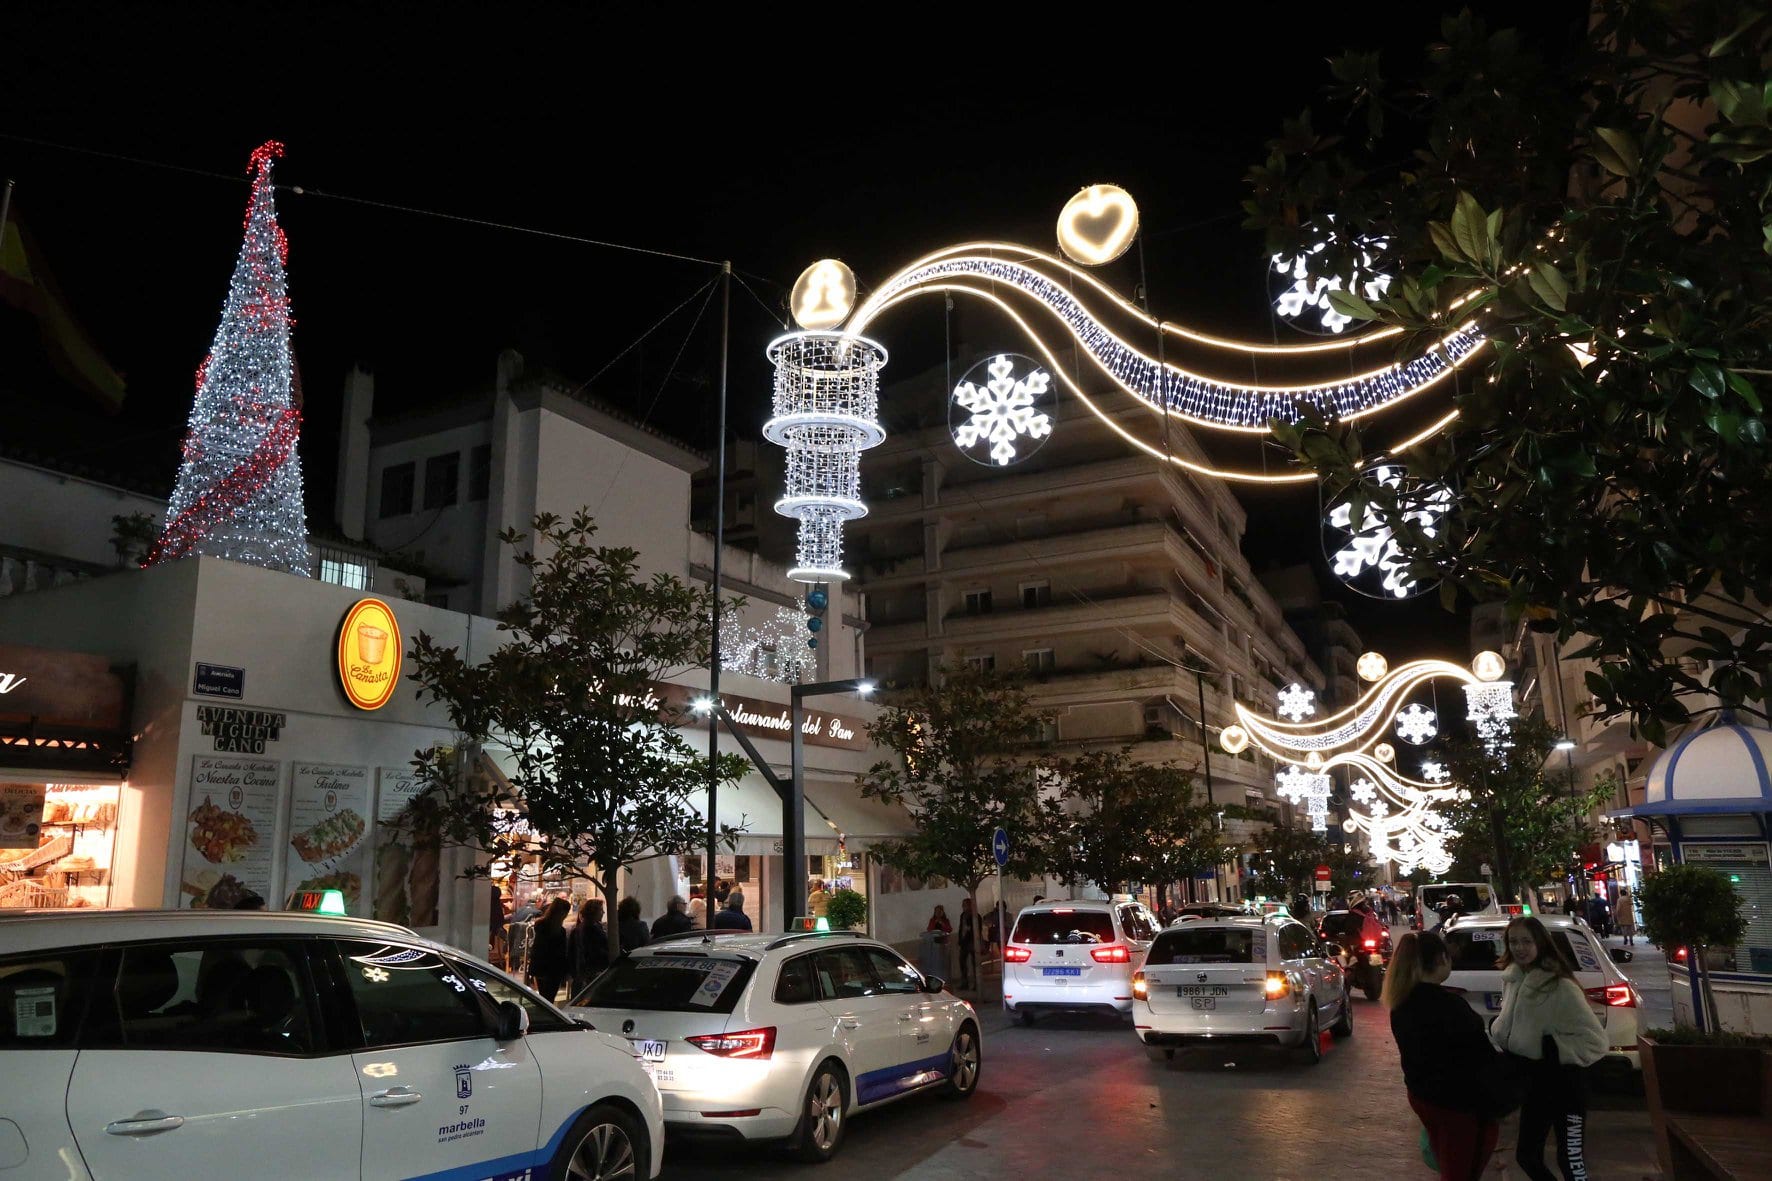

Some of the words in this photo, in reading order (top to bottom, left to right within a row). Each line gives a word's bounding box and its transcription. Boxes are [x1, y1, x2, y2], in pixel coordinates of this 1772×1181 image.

[210, 670, 235, 679] Avenida
[350, 664, 388, 683] Canasta
[198, 683, 220, 692] Miguel
[222, 686, 240, 695] Cano
[198, 707, 284, 728] AVENIDA
[708, 698, 792, 731] staurante
[801, 715, 822, 735] del
[828, 718, 855, 740] Pan
[201, 721, 277, 741] MIGUEL
[215, 738, 264, 753] CANO
[196, 770, 240, 785] Nuestra
[243, 772, 276, 786] Cocina
[699, 962, 717, 971] 88
[1183, 987, 1206, 996] 9861
[1210, 987, 1228, 996] JDN
[1194, 998, 1212, 1008] SP
[459, 1104, 469, 1115] 97
[438, 1118, 485, 1136] marbella
